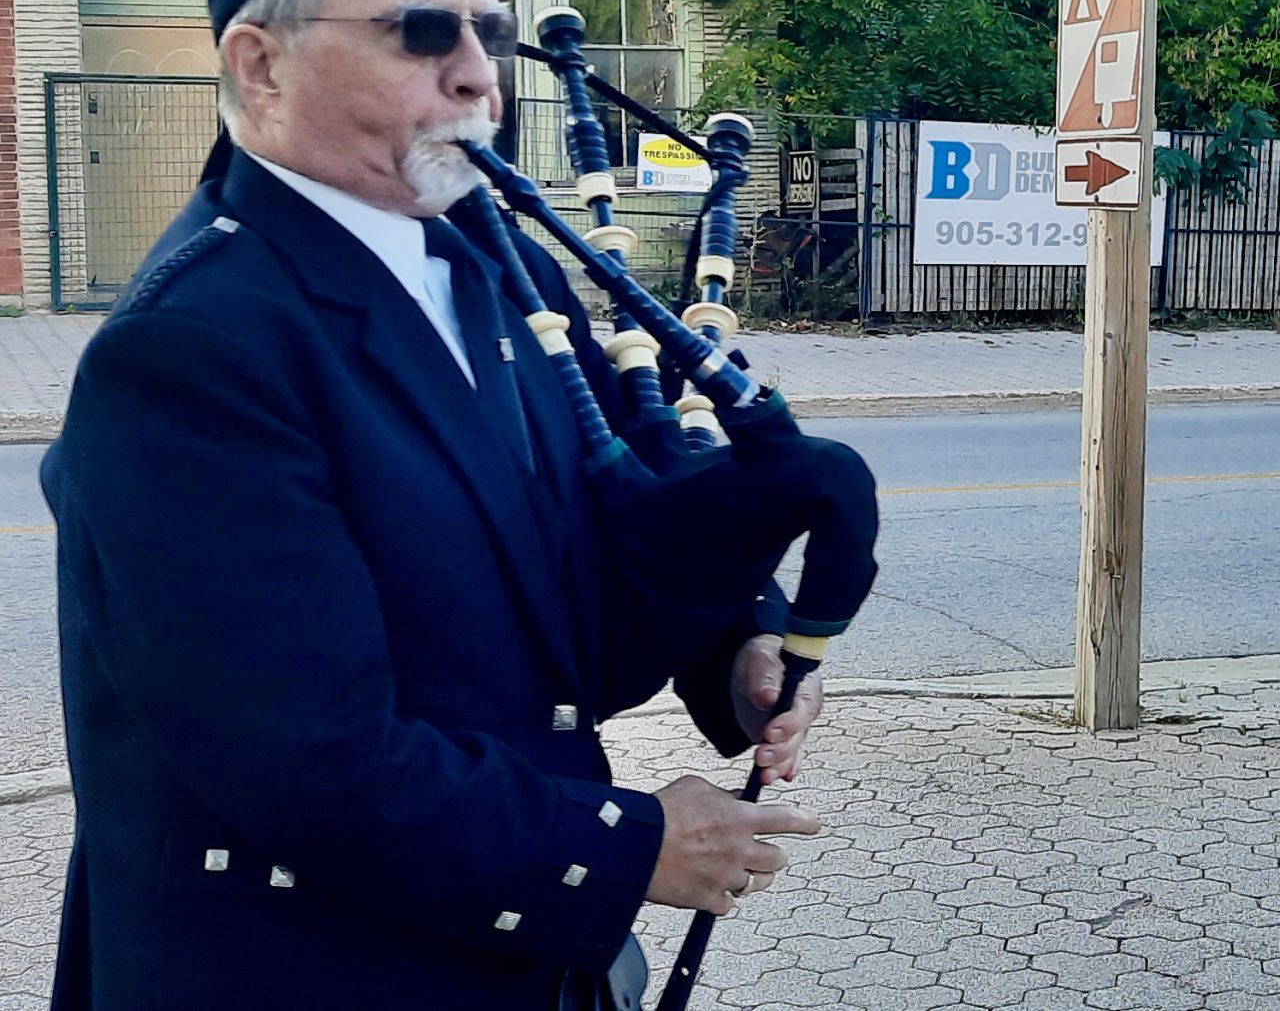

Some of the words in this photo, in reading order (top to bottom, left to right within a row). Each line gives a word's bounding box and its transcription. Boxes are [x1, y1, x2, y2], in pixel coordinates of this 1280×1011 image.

[643, 151, 703, 161] TRESPASSI
[667, 143, 682, 152] NO
[793, 156, 812, 181] NO
[923, 140, 1012, 202] BD
[936, 220, 1088, 248] 905-312-9
